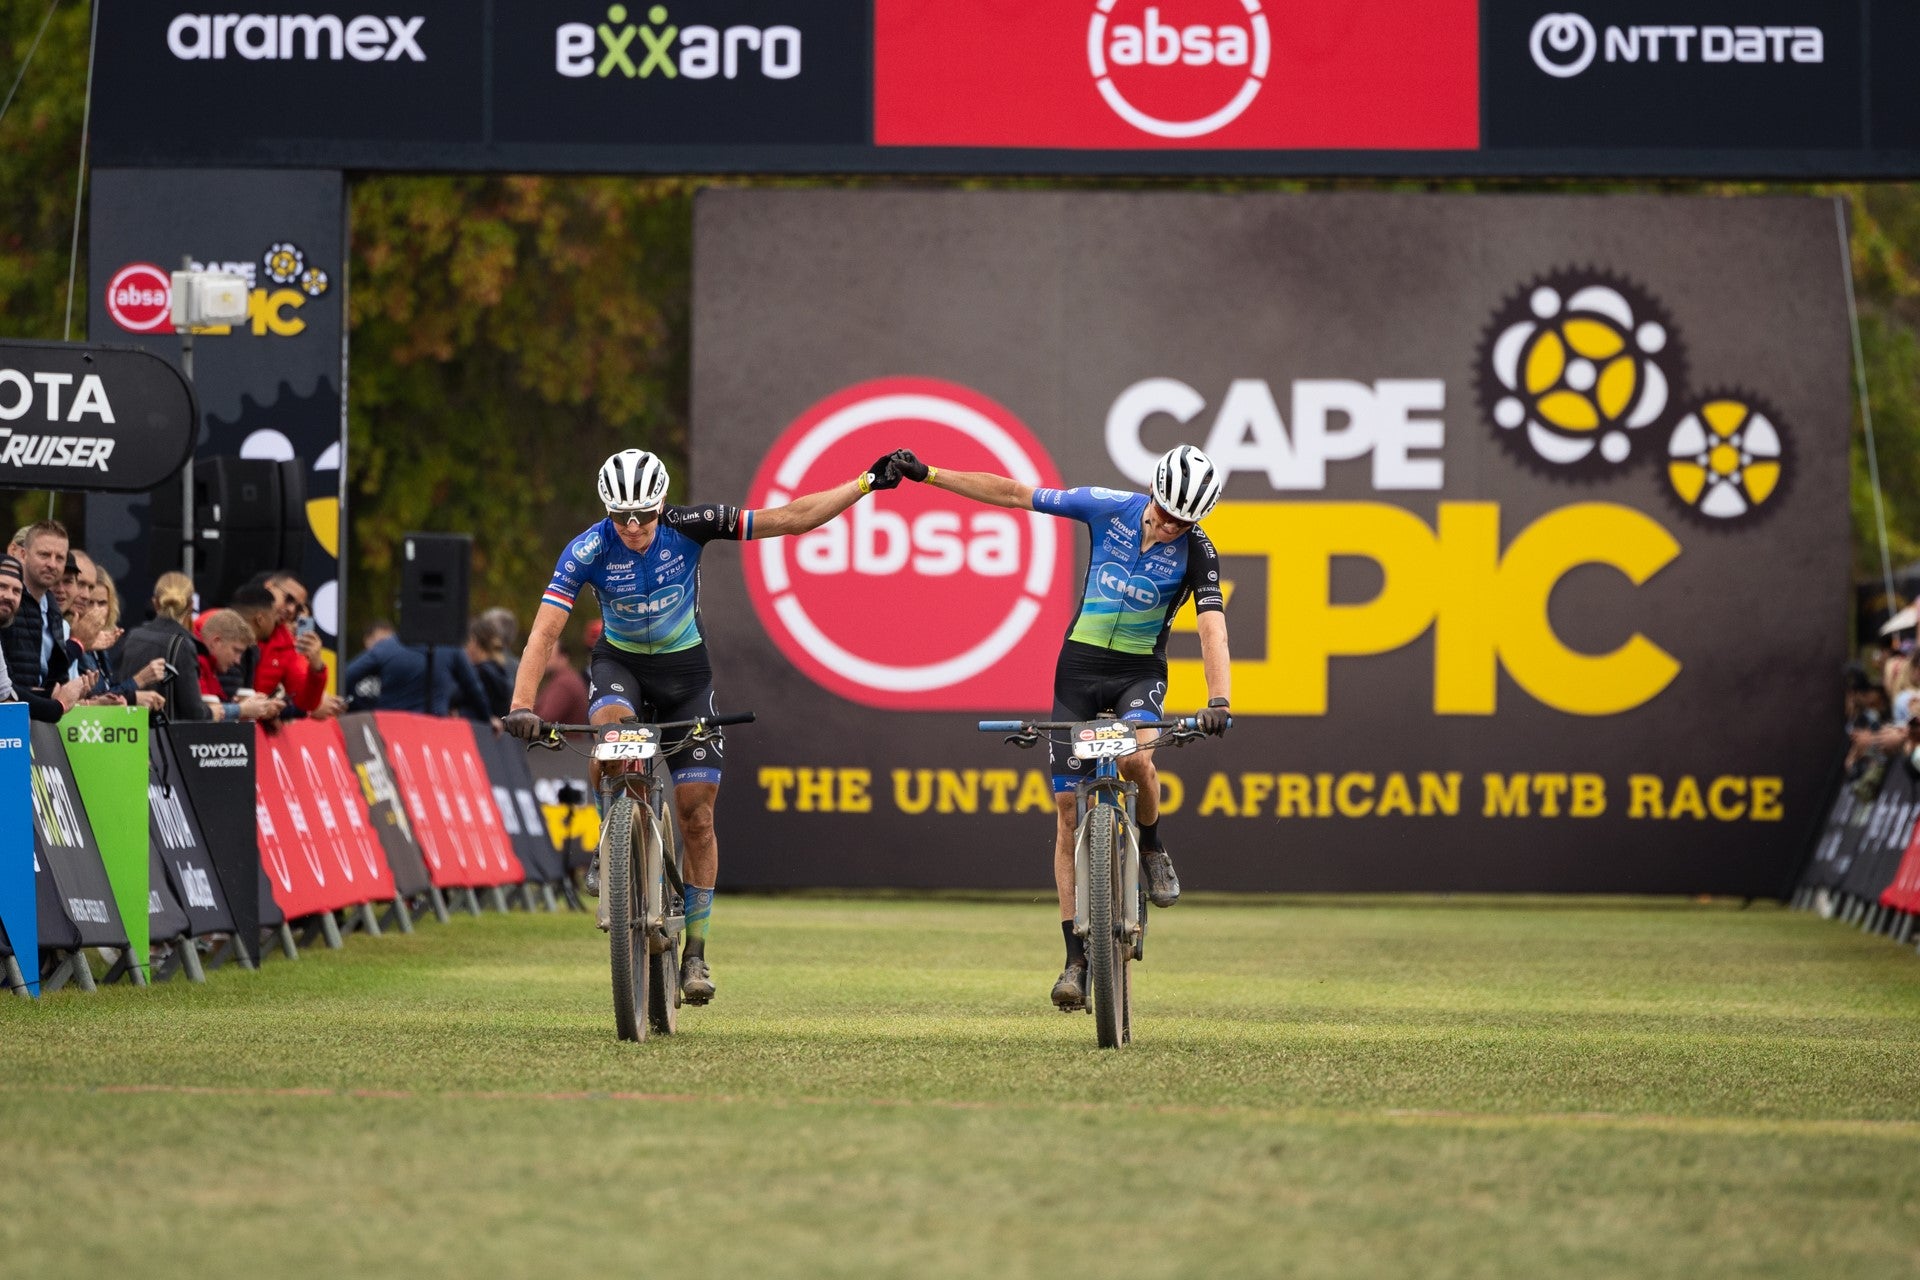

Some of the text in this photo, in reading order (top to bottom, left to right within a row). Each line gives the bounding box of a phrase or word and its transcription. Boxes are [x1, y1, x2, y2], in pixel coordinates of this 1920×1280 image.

[167, 13, 427, 62] aramex
[555, 4, 801, 80] exxaro
[1110, 7, 1249, 66] absa
[1604, 25, 1697, 62] NTT
[116, 284, 166, 307] absa
[1105, 376, 1447, 491] CAPE
[682, 511, 701, 521] Link
[796, 488, 1020, 577] absa
[1205, 542, 1216, 559] Link
[665, 561, 686, 577] TRUE
[1155, 563, 1174, 576] TRUE
[1100, 570, 1155, 605] KMC
[616, 591, 679, 614] KMC
[67, 719, 139, 743] exxaro
[1095, 731, 1125, 740] EPIC
[189, 743, 249, 758] TOYOTA
[612, 744, 643, 754] 17-1
[1088, 740, 1124, 753] 17-2
[758, 767, 1784, 821] THE UNTAD AFRICAN MTB RACE
